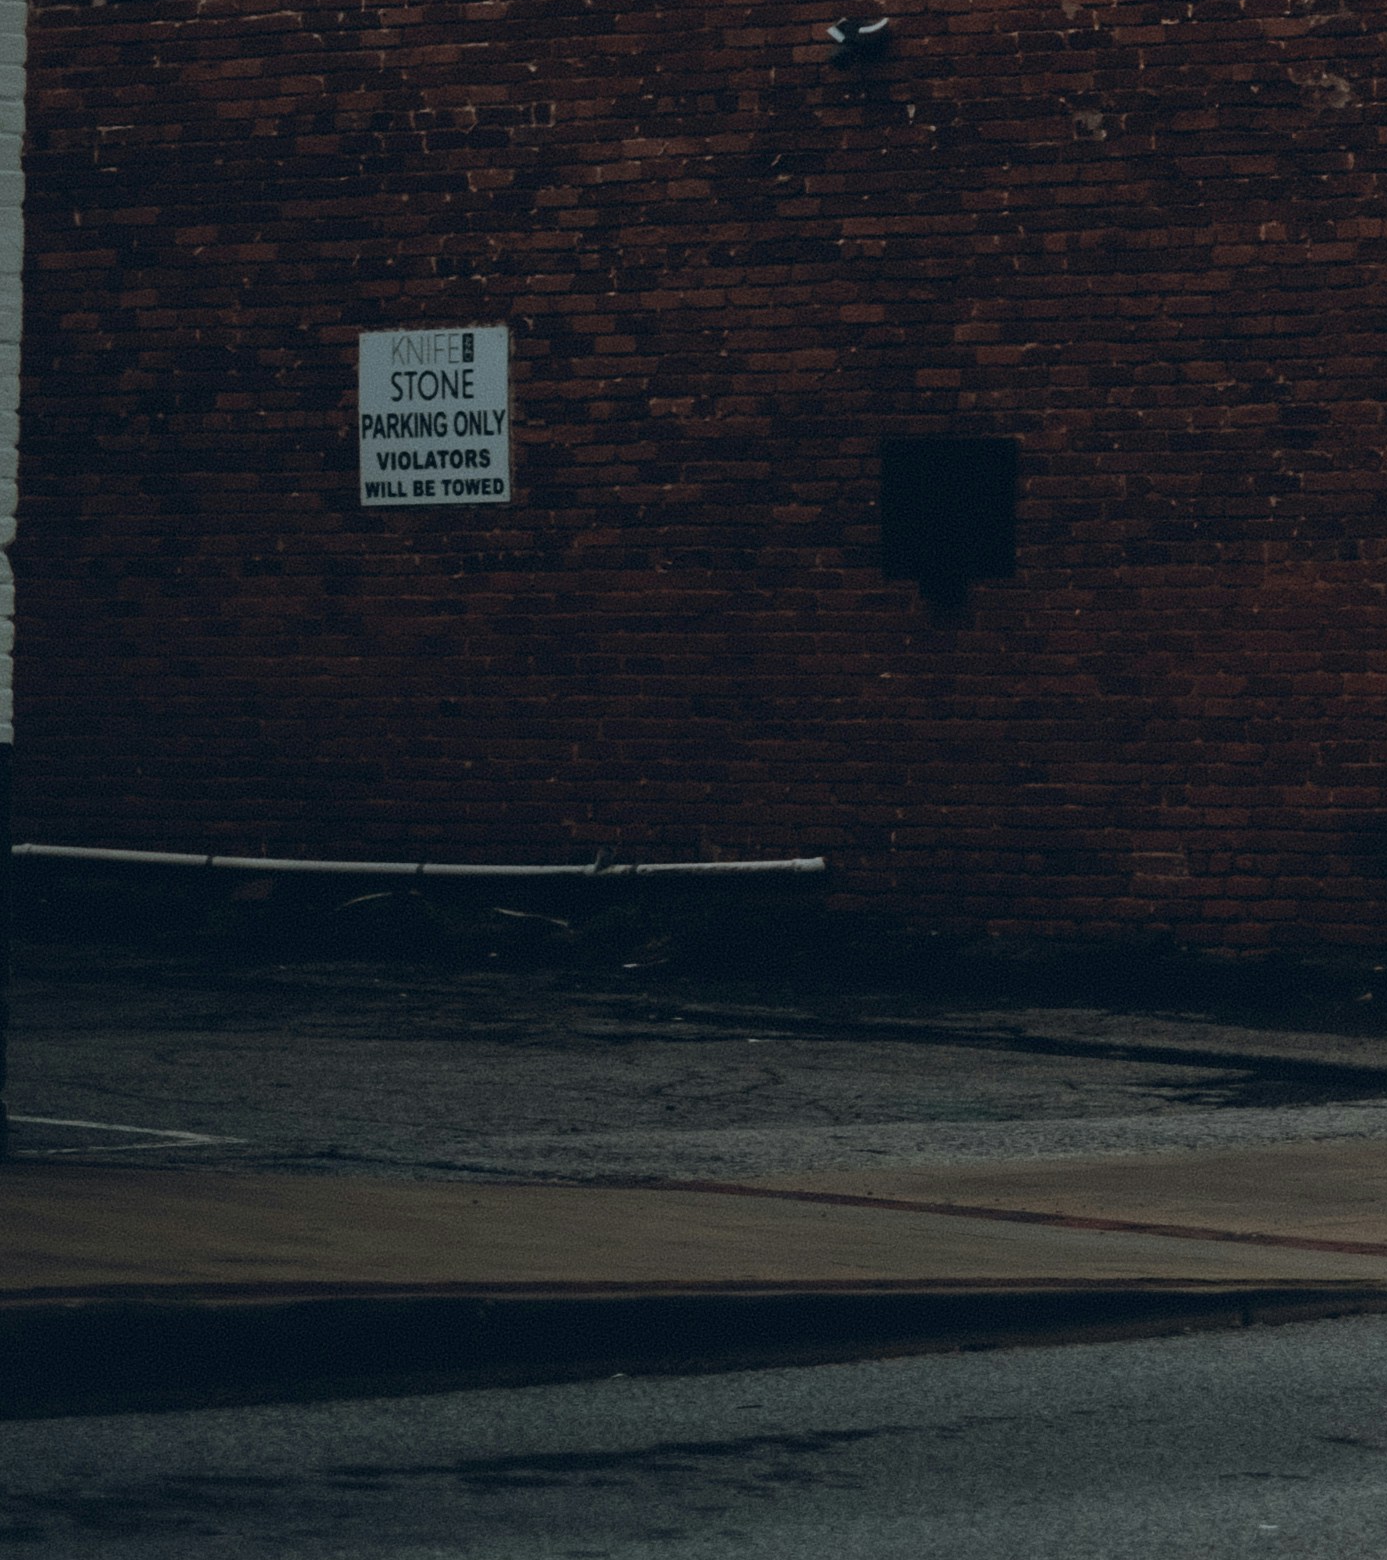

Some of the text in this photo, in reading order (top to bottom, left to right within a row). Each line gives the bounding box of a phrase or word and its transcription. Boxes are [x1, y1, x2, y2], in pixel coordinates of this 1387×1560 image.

[391, 333, 460, 366] KNIFE
[391, 368, 474, 402] STONE
[362, 409, 506, 439] PARKING ONLY
[376, 448, 491, 471] VIOLATORS
[365, 477, 505, 499] WILL BE TOWED
